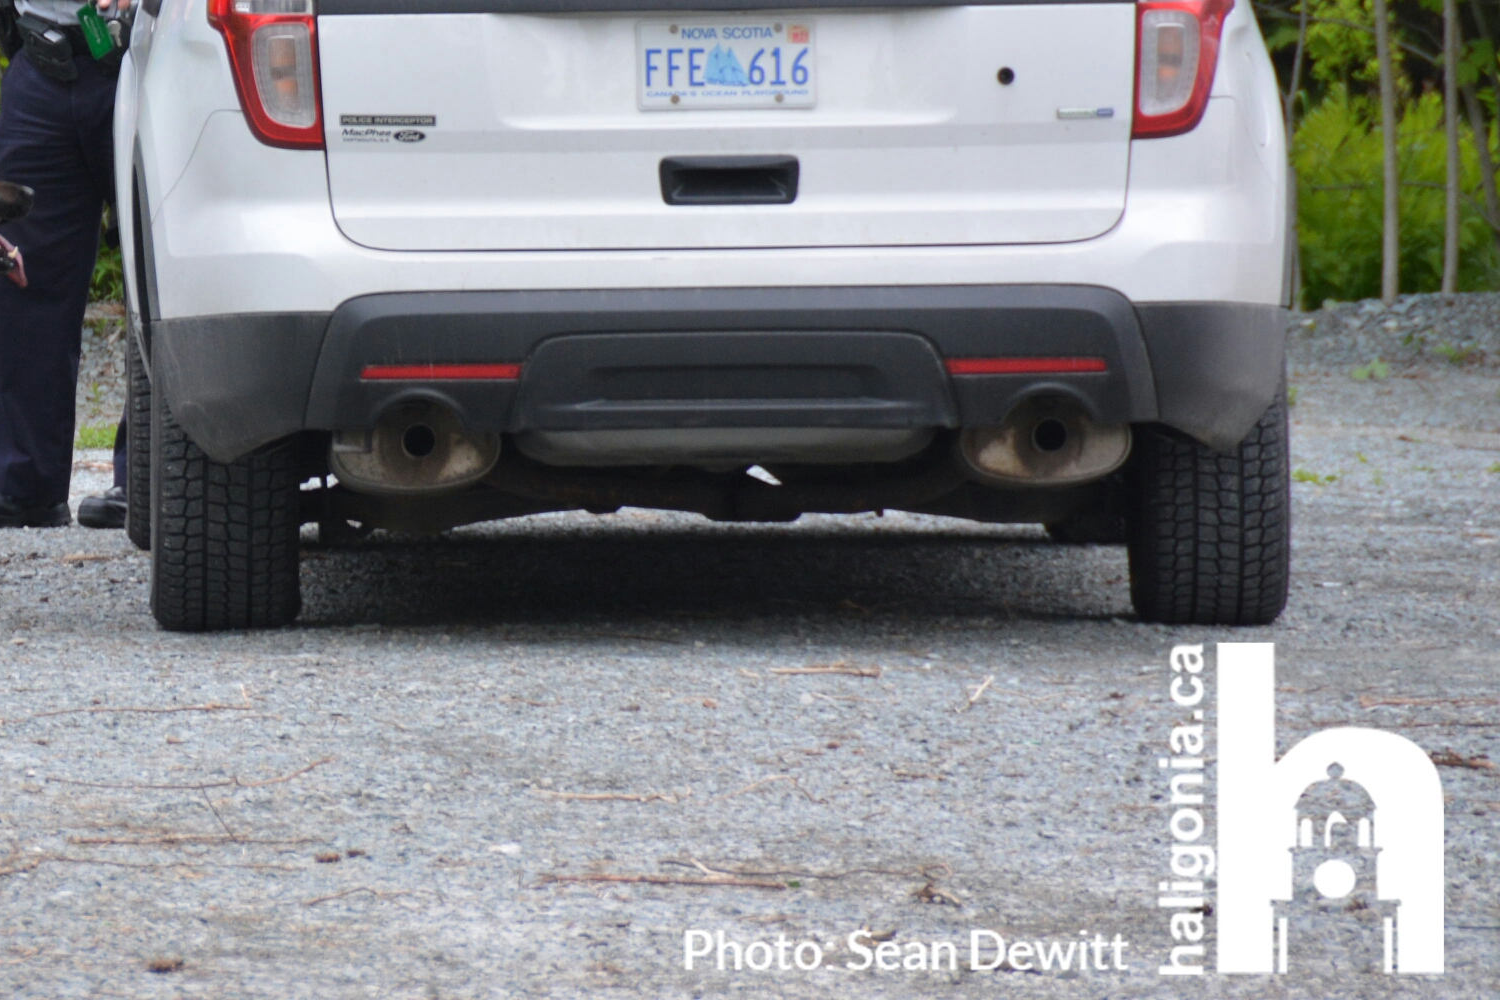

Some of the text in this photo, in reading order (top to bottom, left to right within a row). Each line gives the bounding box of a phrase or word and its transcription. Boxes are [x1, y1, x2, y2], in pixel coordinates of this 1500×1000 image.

[681, 27, 718, 40] NOVA
[722, 26, 773, 40] SCOTIA
[645, 47, 809, 87] FFE 616
[646, 88, 809, 98] CANADA'S OCEAN PLAYGROUND
[342, 116, 433, 124] POLICE INTERCEPTOR
